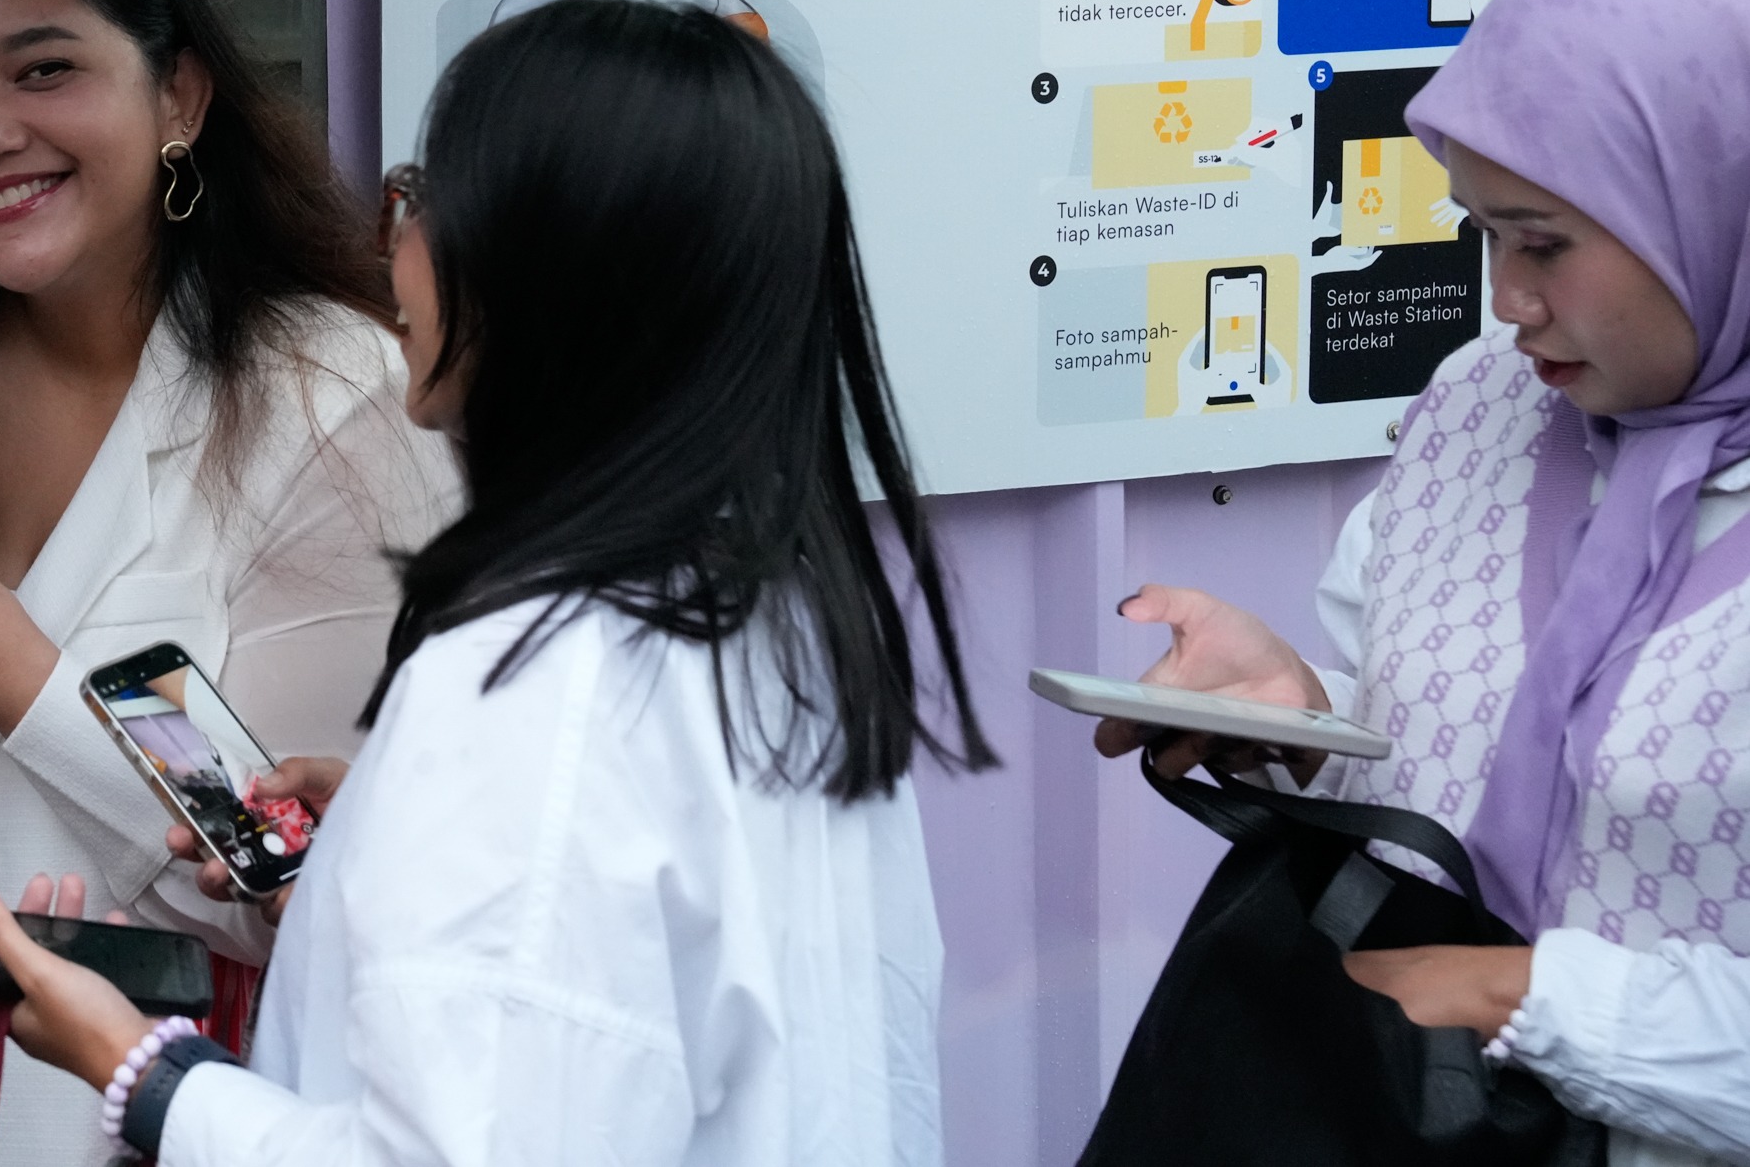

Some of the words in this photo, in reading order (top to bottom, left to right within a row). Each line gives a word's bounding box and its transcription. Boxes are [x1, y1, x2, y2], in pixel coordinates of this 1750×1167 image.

[1059, 4, 1101, 21] tidak
[1109, 5, 1185, 19] tercecer.
[1316, 69, 1325, 83] 5
[1040, 81, 1050, 95] 3
[1057, 200, 1127, 218] Tuliskan
[1136, 193, 1216, 213] Waste-ID
[1224, 191, 1238, 208] di
[1057, 228, 1089, 245] tiap
[1098, 224, 1173, 239] kemasan
[1038, 263, 1049, 277] 4
[1327, 290, 1371, 306] Setor
[1378, 282, 1466, 303] sampahmu
[1327, 313, 1340, 329] di
[1348, 310, 1398, 327] Waste
[1406, 306, 1461, 322] Station
[1057, 330, 1094, 346] Foto
[1102, 322, 1177, 344] sampah-
[1326, 332, 1394, 352] terdekat
[1055, 349, 1151, 371] sampahmu
